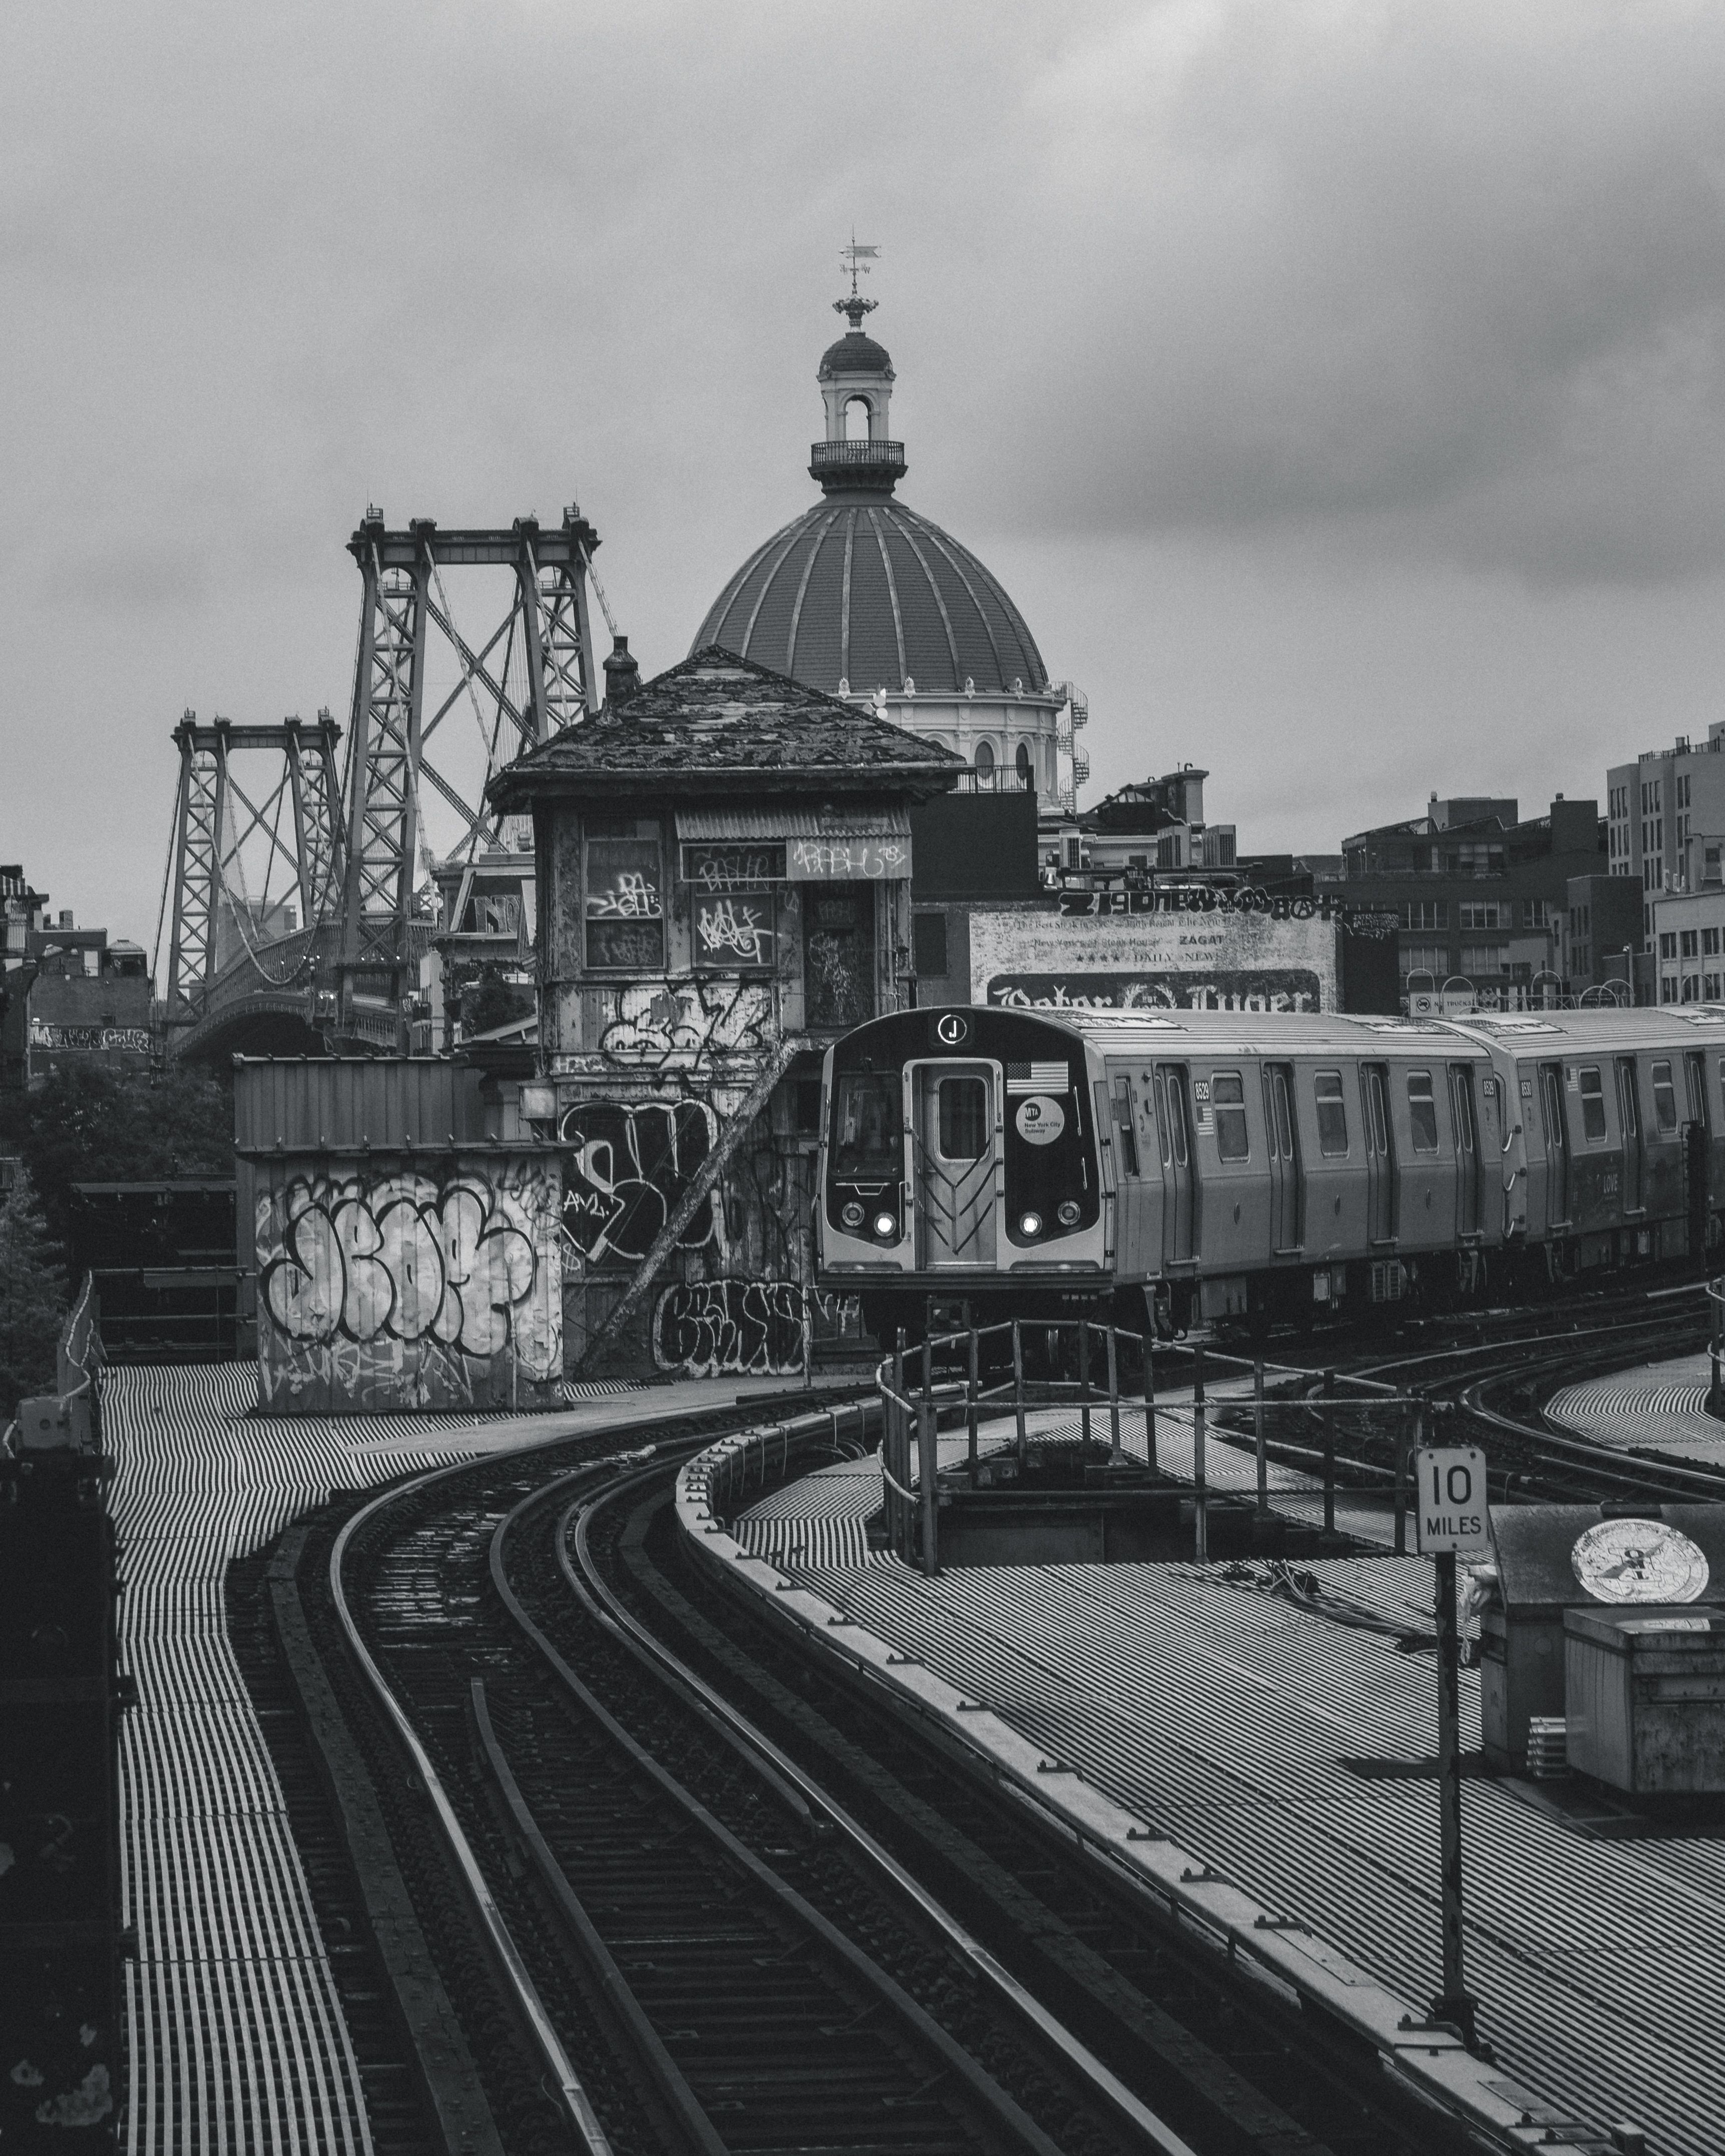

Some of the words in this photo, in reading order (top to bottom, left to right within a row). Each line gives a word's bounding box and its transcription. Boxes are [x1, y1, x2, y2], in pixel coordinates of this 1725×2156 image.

[1179, 935, 1224, 945] ZAGAT
[1134, 953, 1172, 962] DAILY
[1185, 952, 1223, 962] NEWS
[949, 1020, 957, 1038] J
[1195, 1082, 1209, 1100] 8529
[1483, 1080, 1494, 1095] 8529
[1025, 1107, 1039, 1118] MTA
[1603, 1173, 1618, 1194] LOVE
[1433, 1465, 1472, 1505] 10
[1427, 1516, 1482, 1536] MILES
